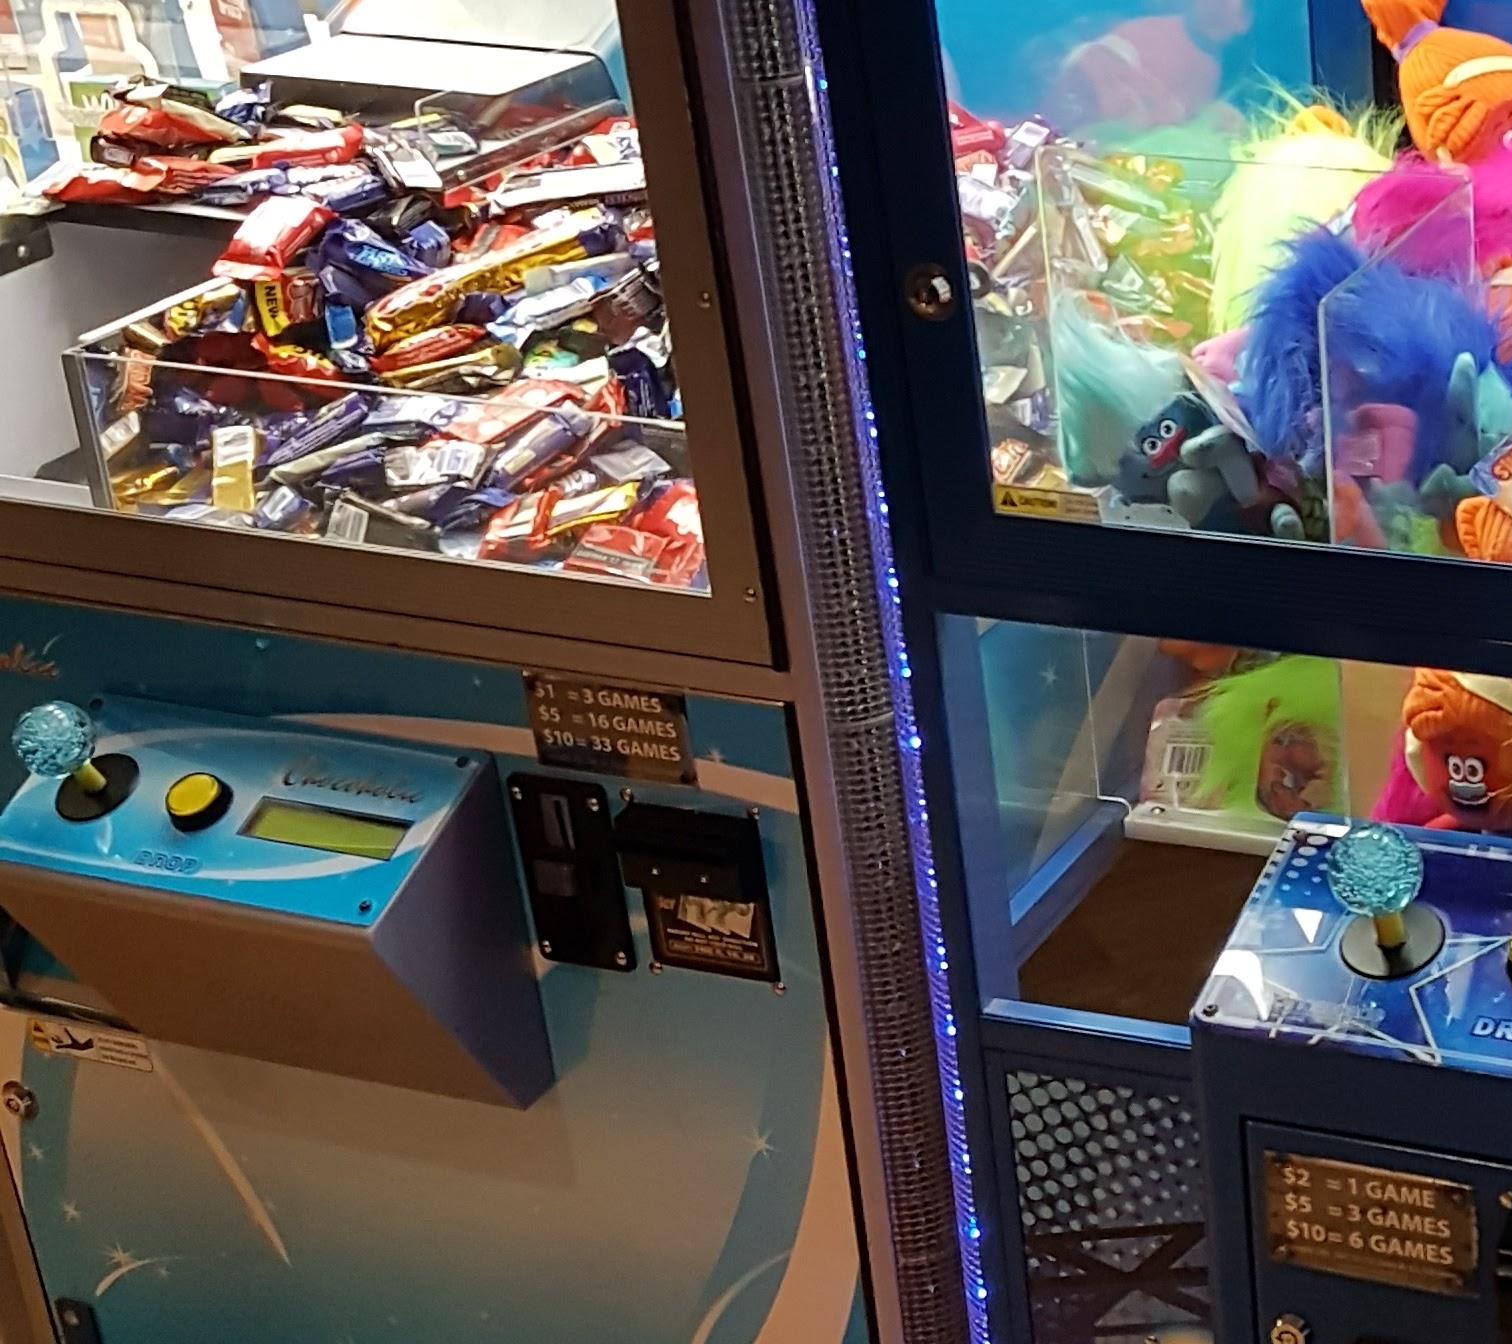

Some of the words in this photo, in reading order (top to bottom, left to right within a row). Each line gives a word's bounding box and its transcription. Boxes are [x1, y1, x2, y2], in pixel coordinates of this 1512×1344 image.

[583, 688, 595, 705] 3
[597, 691, 662, 713] GAMES
[538, 705, 561, 723] $5
[588, 712, 610, 729] 16
[612, 716, 677, 738] GAMES
[592, 736, 613, 752] 33
[617, 739, 681, 762] GAMES
[133, 849, 198, 873] DROP
[1283, 1167, 1311, 1188] $2
[1347, 1178, 1358, 1195] 1
[1365, 1181, 1436, 1209] GAME
[1284, 1192, 1313, 1213] $5
[1348, 1205, 1361, 1222] 3
[1367, 1207, 1450, 1238] GAMES
[1349, 1232, 1364, 1249] 6
[1369, 1235, 1455, 1265] GAMES
